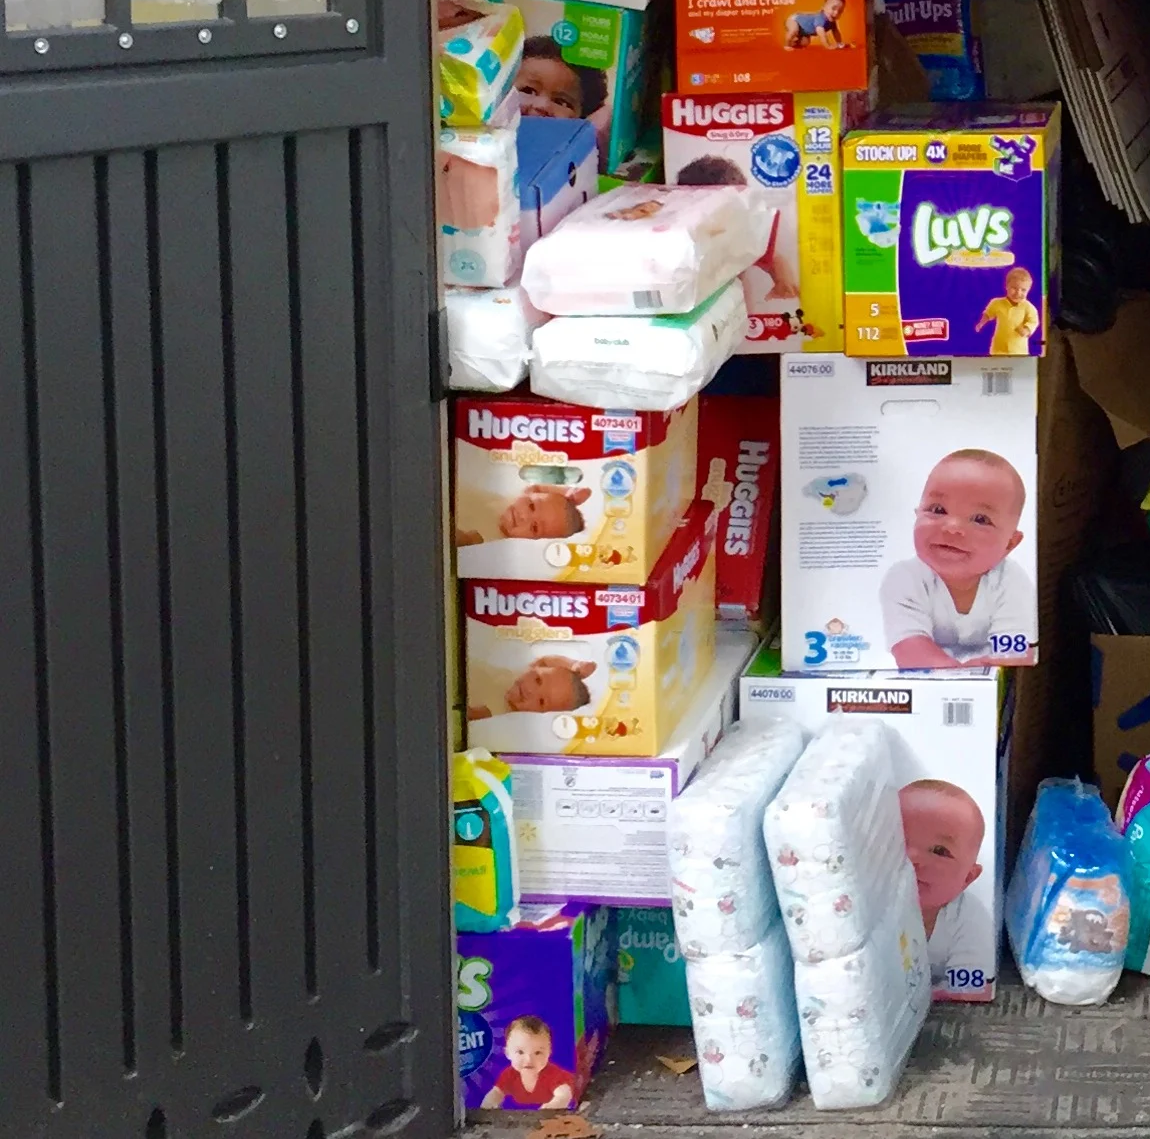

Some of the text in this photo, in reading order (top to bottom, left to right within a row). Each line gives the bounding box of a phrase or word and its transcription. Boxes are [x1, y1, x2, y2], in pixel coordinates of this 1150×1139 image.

[733, 73, 751, 83] 108
[672, 98, 784, 127] HUGGIES
[808, 128, 831, 143] 12
[856, 145, 945, 161] STOCK UP! 4X
[806, 165, 831, 180] 24
[870, 304, 879, 316] 5
[763, 317, 783, 328] 180
[857, 327, 880, 340] 112
[870, 363, 949, 376] KIRKLAND
[468, 409, 586, 443] HUGGIES
[724, 440, 770, 556] HUGGIES
[474, 587, 590, 618] HUGGIES
[804, 631, 827, 663] 3
[989, 634, 1027, 653] 198
[830, 690, 910, 704] KIRKLAND
[947, 969, 985, 988] 198
